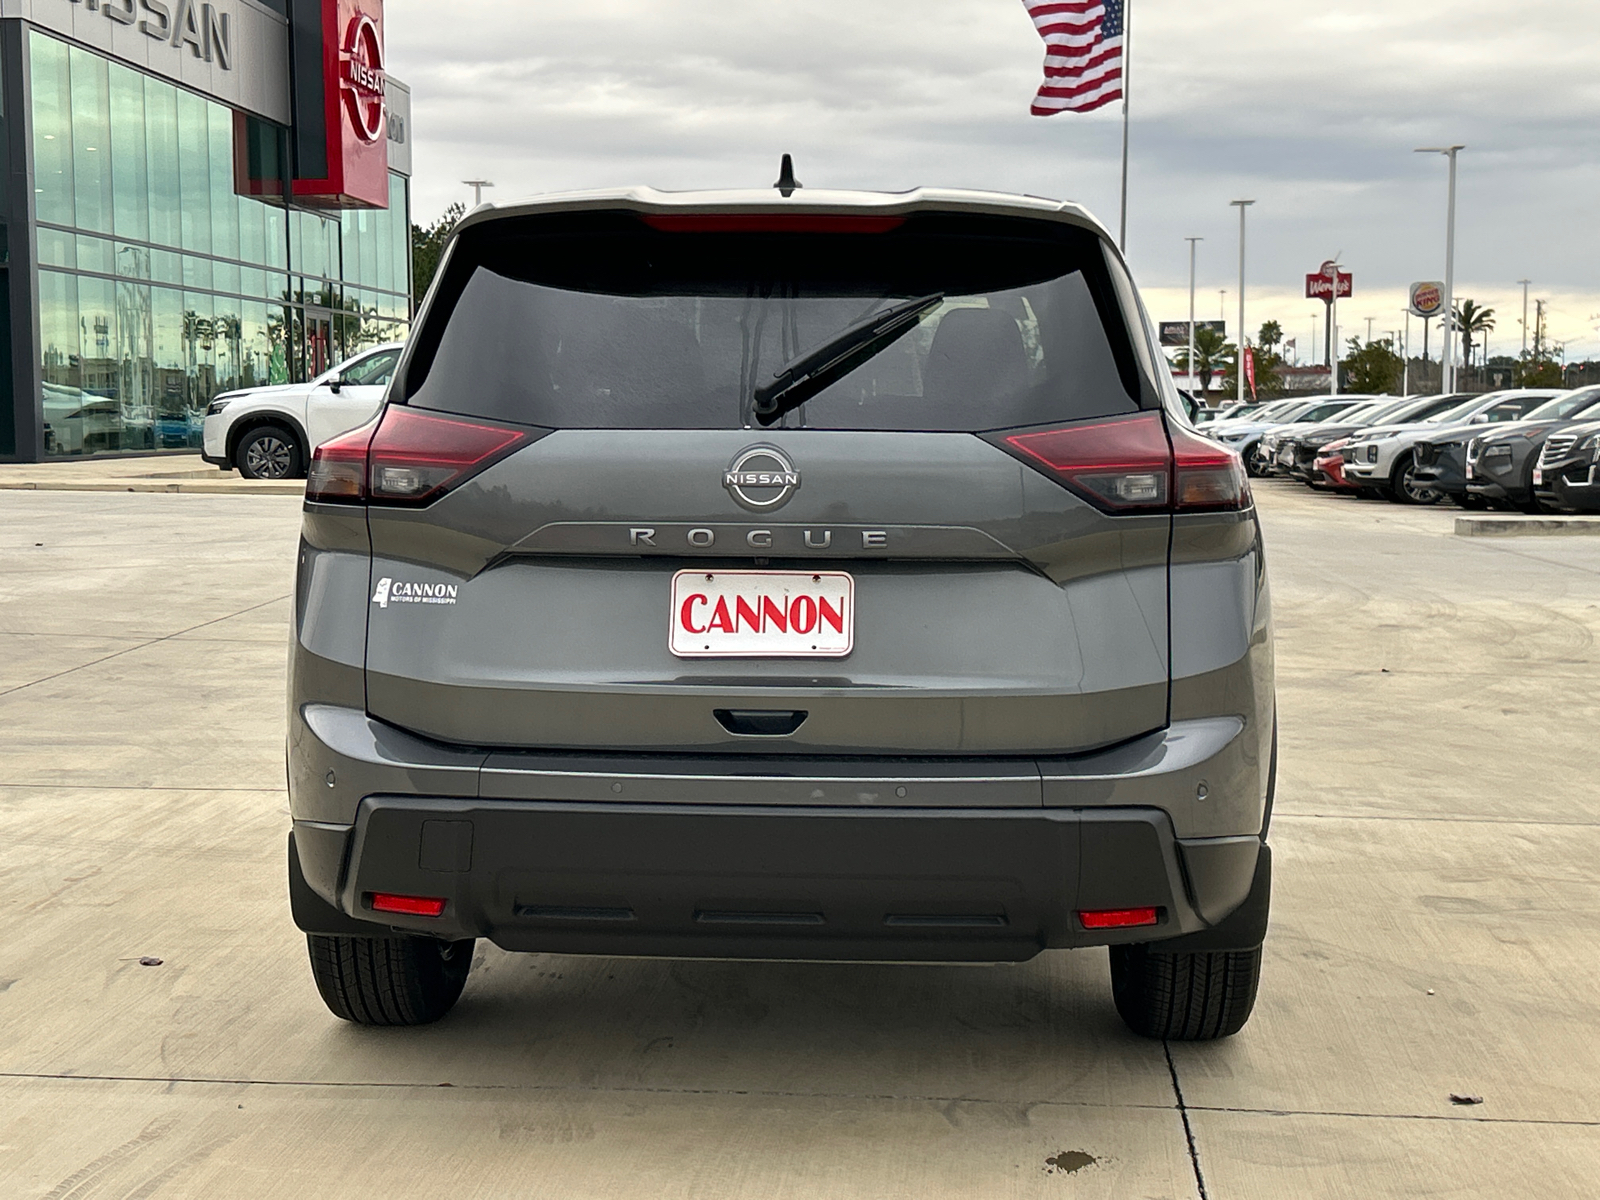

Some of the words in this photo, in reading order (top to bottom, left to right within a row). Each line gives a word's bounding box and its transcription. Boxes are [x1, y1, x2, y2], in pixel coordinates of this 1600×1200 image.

[350, 60, 386, 95] NISSAN
[726, 474, 797, 485] NISSAN
[629, 528, 888, 549] ROGUE
[392, 582, 458, 597] CANNON
[680, 593, 844, 635] CANNON
